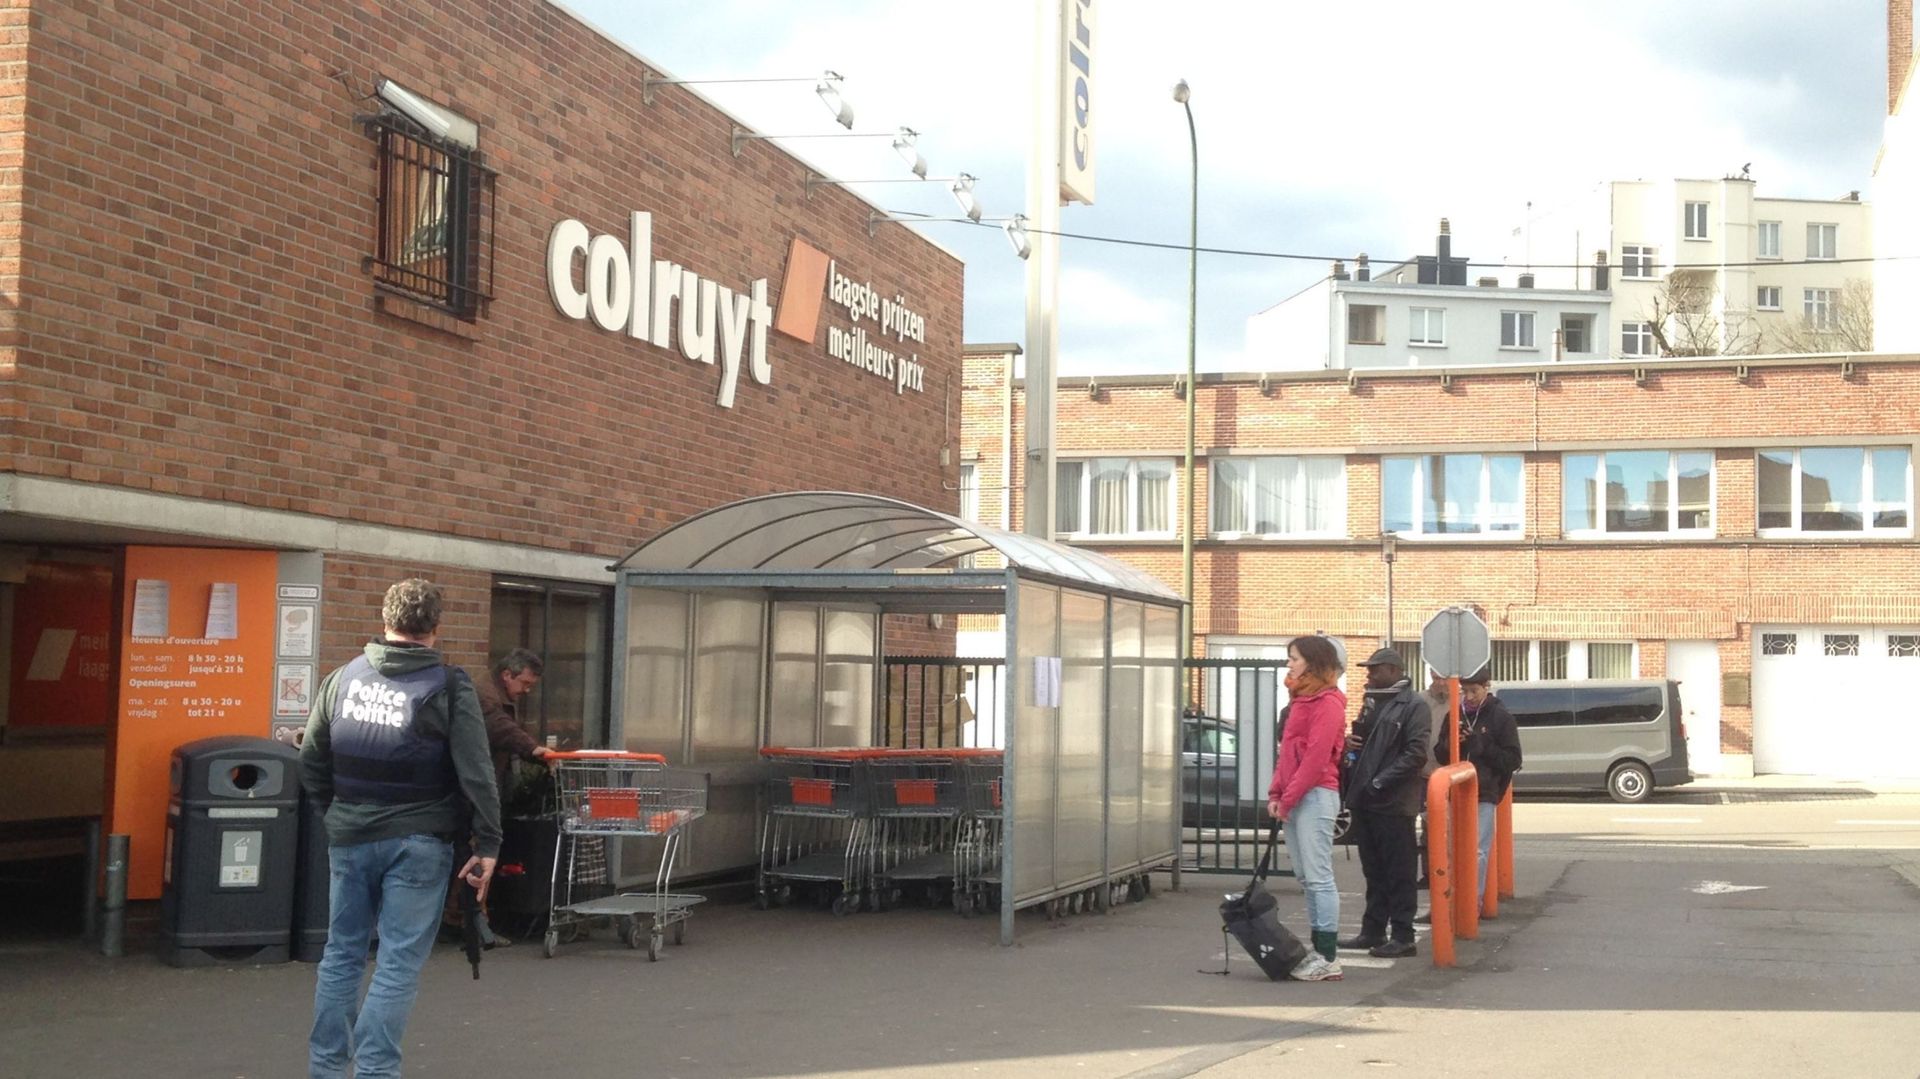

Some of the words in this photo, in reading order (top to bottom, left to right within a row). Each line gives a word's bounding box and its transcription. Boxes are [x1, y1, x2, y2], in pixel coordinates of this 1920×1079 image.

[1069, 0, 1091, 172] colr
[547, 210, 773, 409] colruyt
[829, 259, 879, 322] laagste
[881, 294, 925, 343] prijzen
[828, 325, 895, 381] meilleurs
[897, 353, 924, 395] prix
[131, 636, 165, 645] Heures
[166, 636, 220, 646] d'ouverture
[188, 654, 194, 663] 8
[196, 654, 203, 663] h
[205, 654, 216, 663] 30
[224, 654, 236, 663] 20
[237, 654, 244, 663] h
[225, 665, 234, 673] 21
[237, 664, 244, 673] h
[128, 678, 197, 689] Openingsuren
[347, 679, 406, 707] Police
[182, 697, 189, 706] 8
[191, 698, 198, 706] u
[200, 697, 212, 706] 30
[220, 697, 233, 706] 20
[235, 698, 242, 706] u
[188, 708, 203, 717] tot
[203, 709, 215, 717] 21
[218, 709, 225, 717] u
[342, 698, 404, 727] Politie
